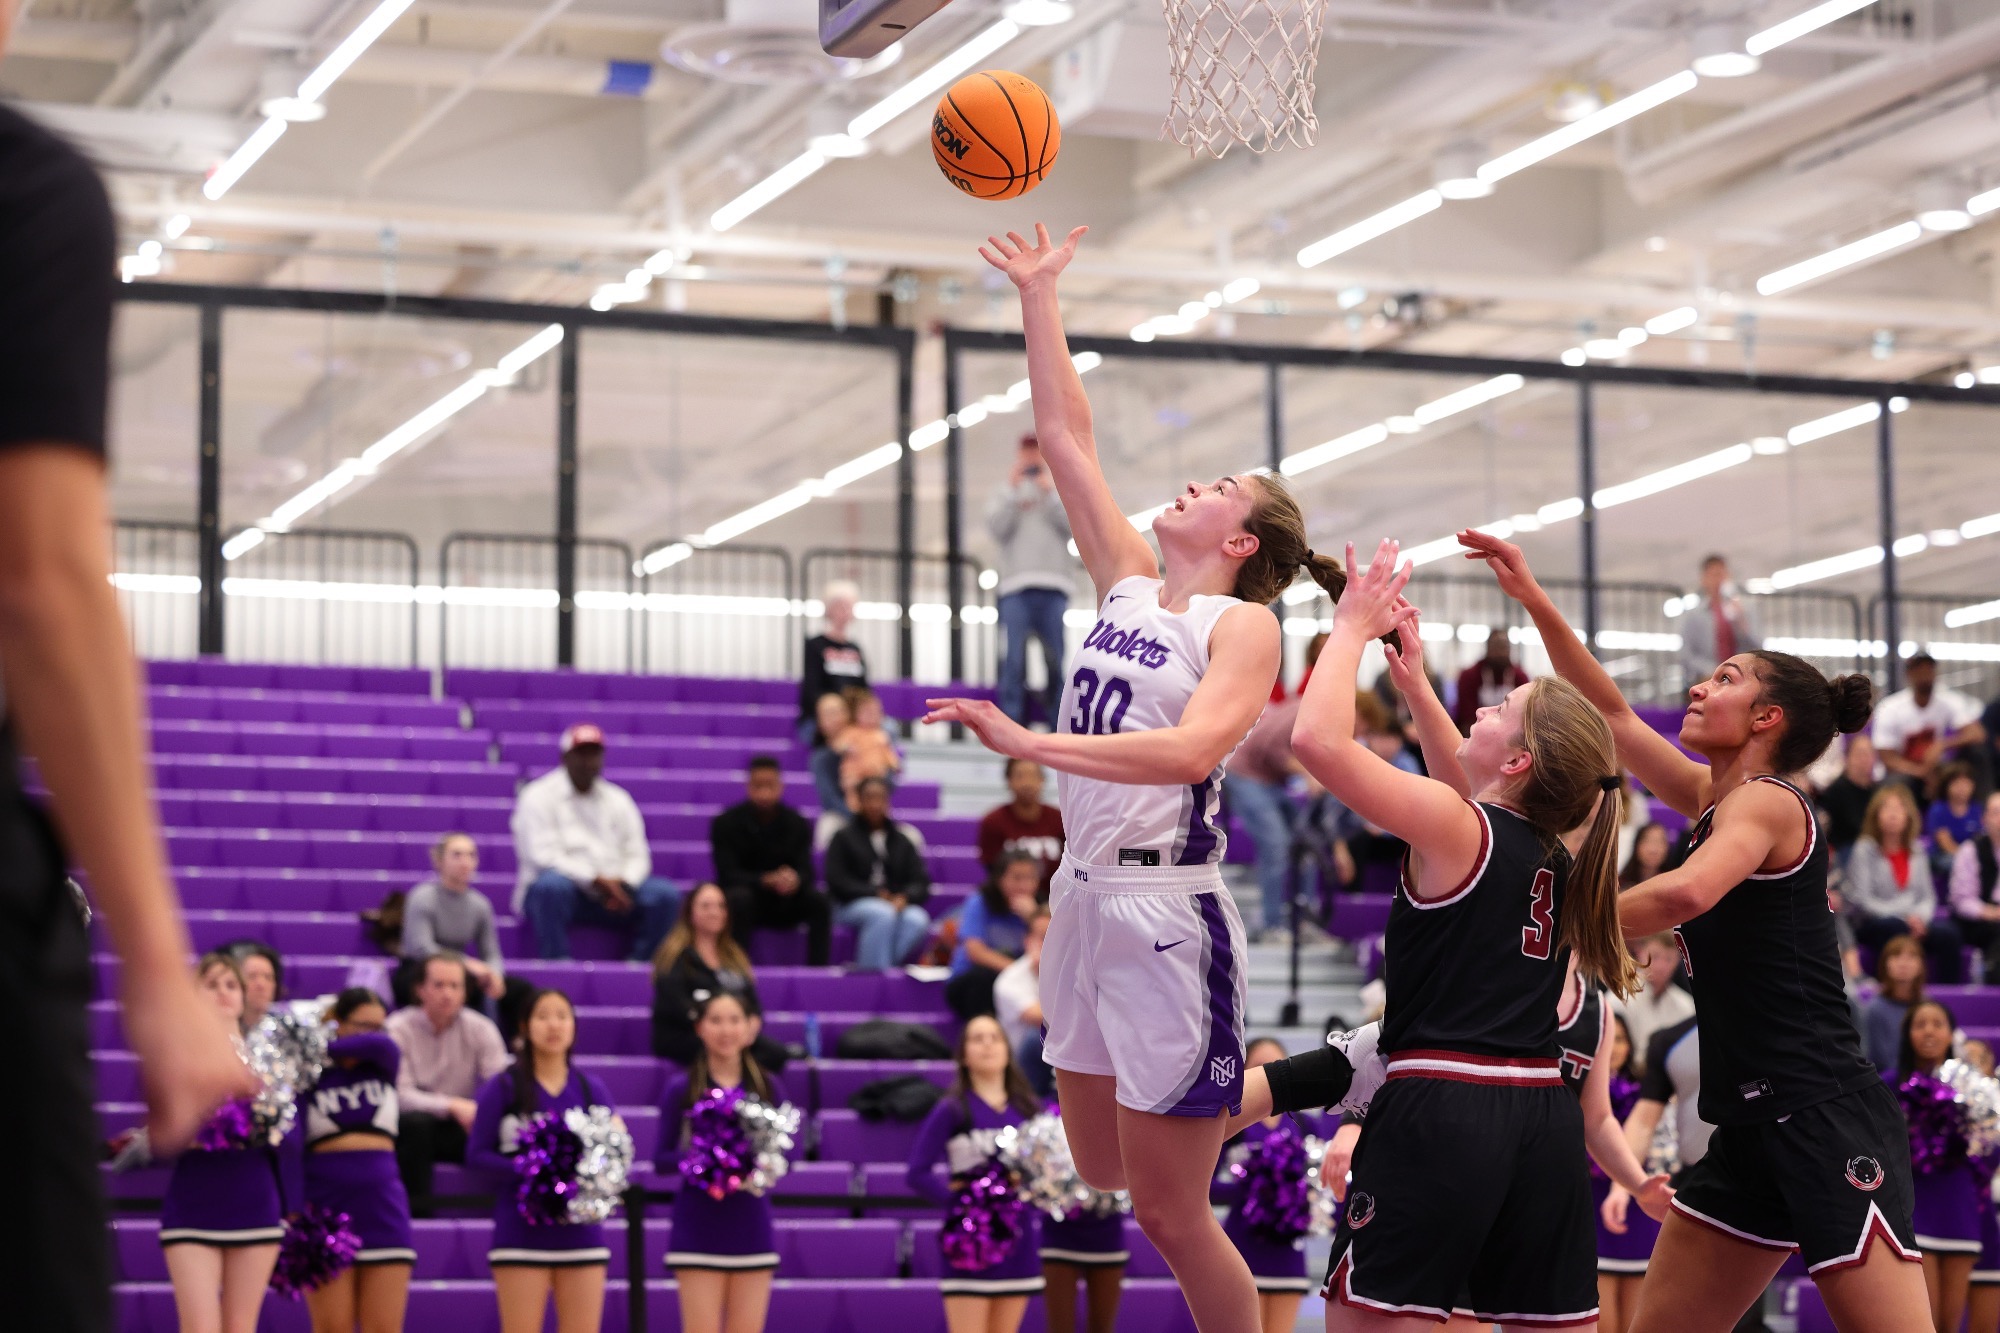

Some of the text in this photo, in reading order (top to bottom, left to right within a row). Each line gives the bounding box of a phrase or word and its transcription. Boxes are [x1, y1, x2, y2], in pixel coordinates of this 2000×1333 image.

[932, 109, 970, 160] NCAA
[1083, 617, 1172, 670] Violets
[1070, 665, 1134, 735] 30
[1074, 867, 1088, 882] NYU
[1147, 856, 1153, 864] L
[1521, 868, 1554, 960] 3
[315, 1080, 382, 1117] NYU
